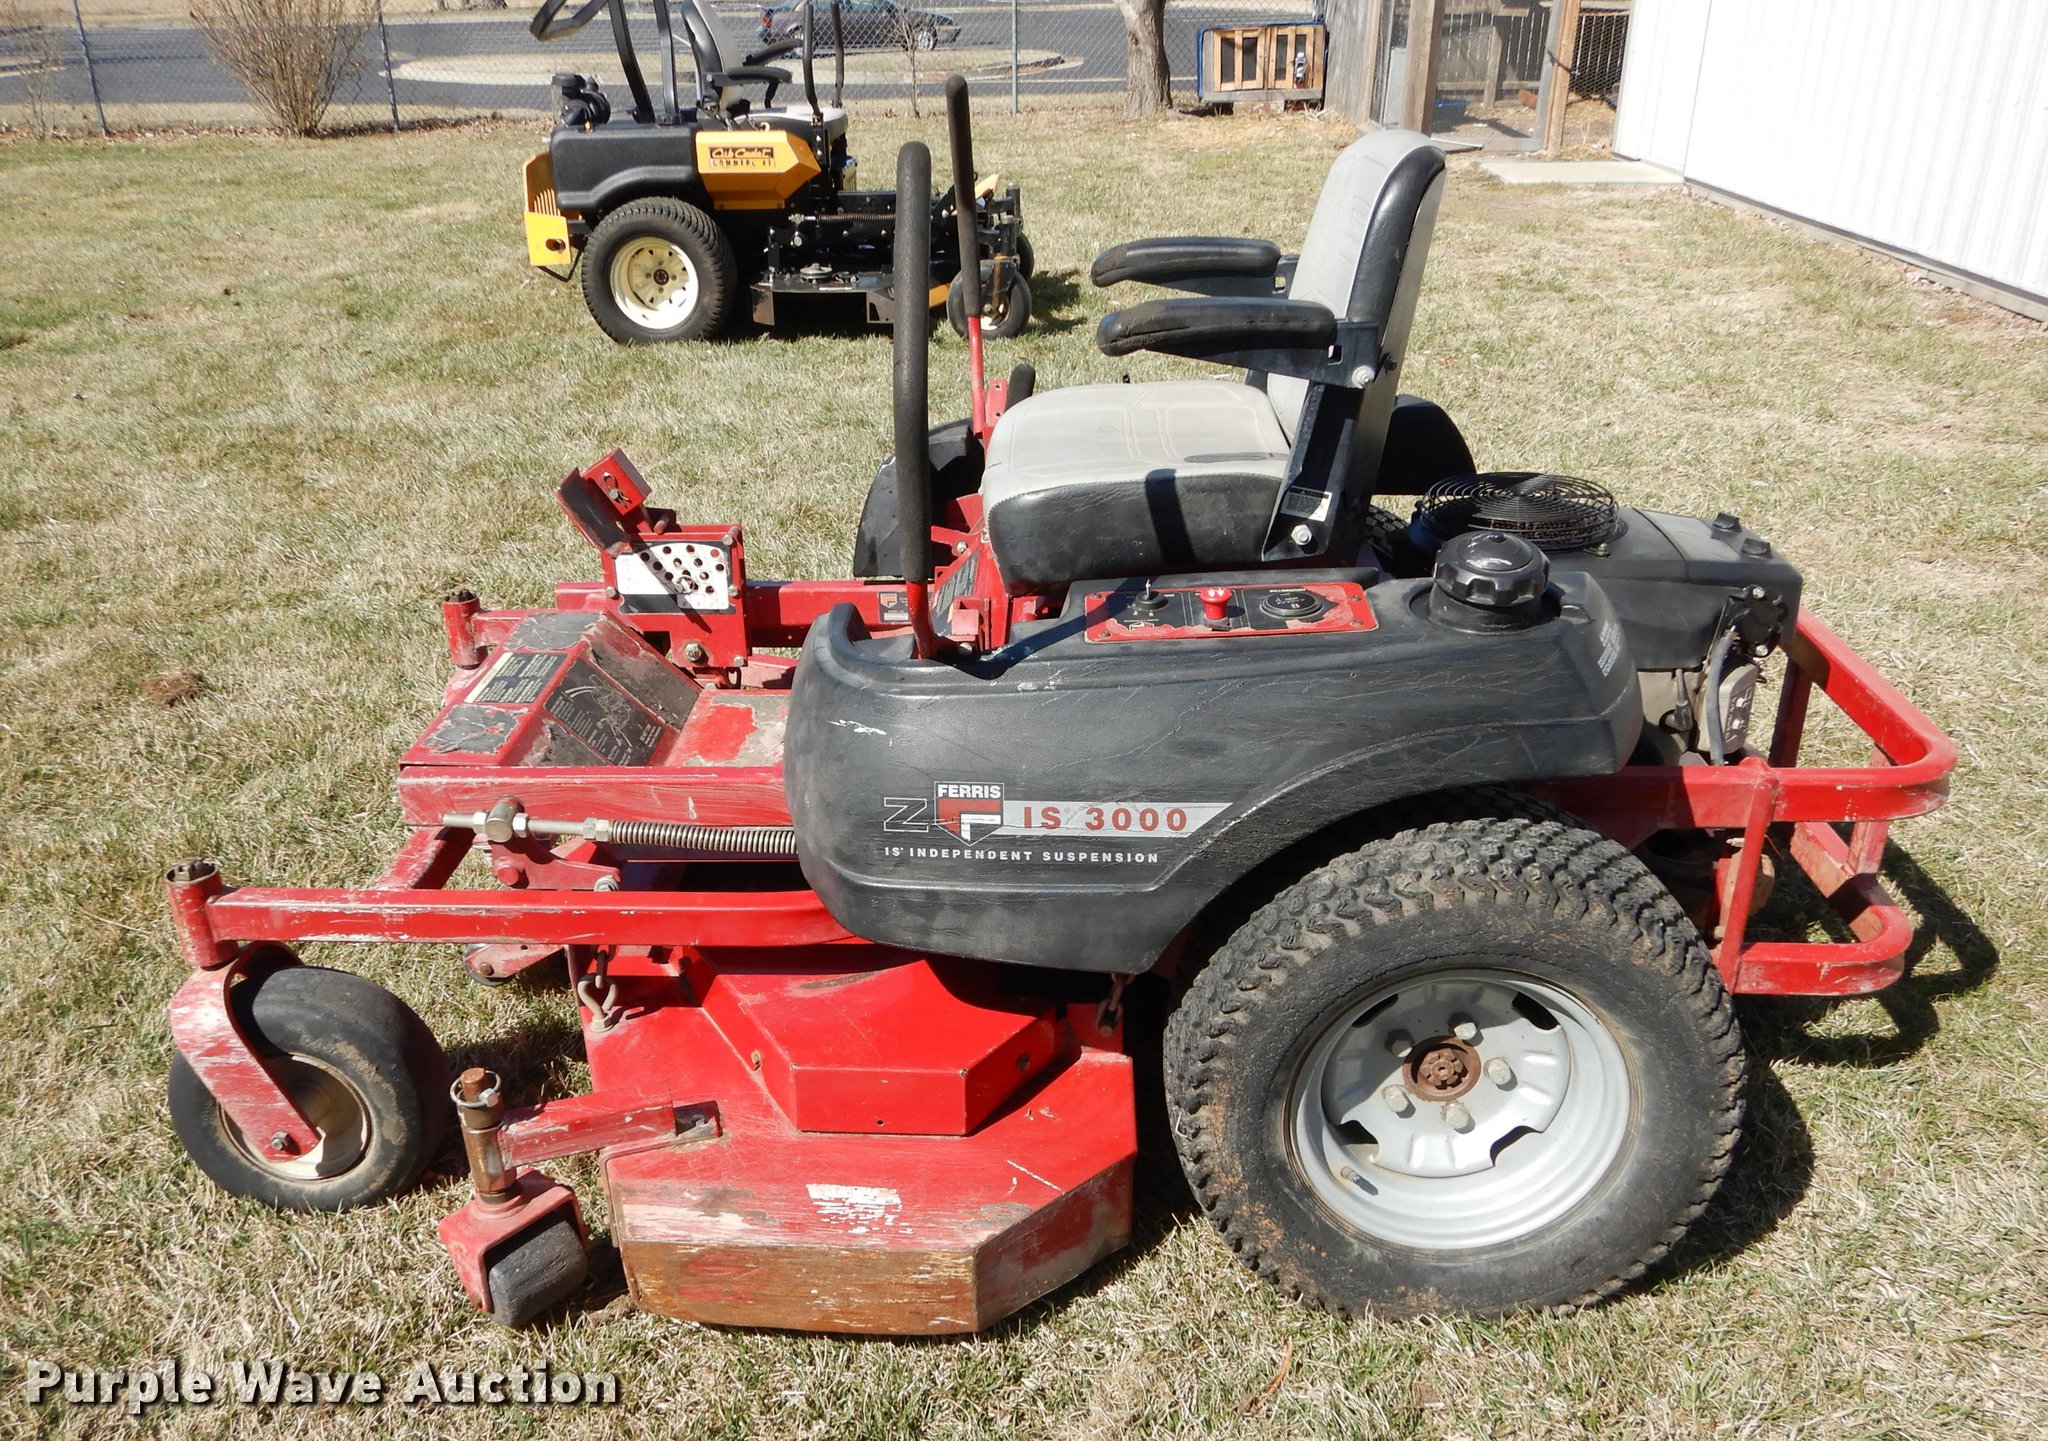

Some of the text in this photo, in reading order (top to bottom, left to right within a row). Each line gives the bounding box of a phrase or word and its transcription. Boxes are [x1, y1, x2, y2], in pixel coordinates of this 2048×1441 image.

[937, 784, 1001, 799] FERRIS
[1085, 807, 1187, 831] 3000
[909, 847, 1033, 861] INDEPENDENT
[1042, 851, 1158, 863] SUSPENSION
